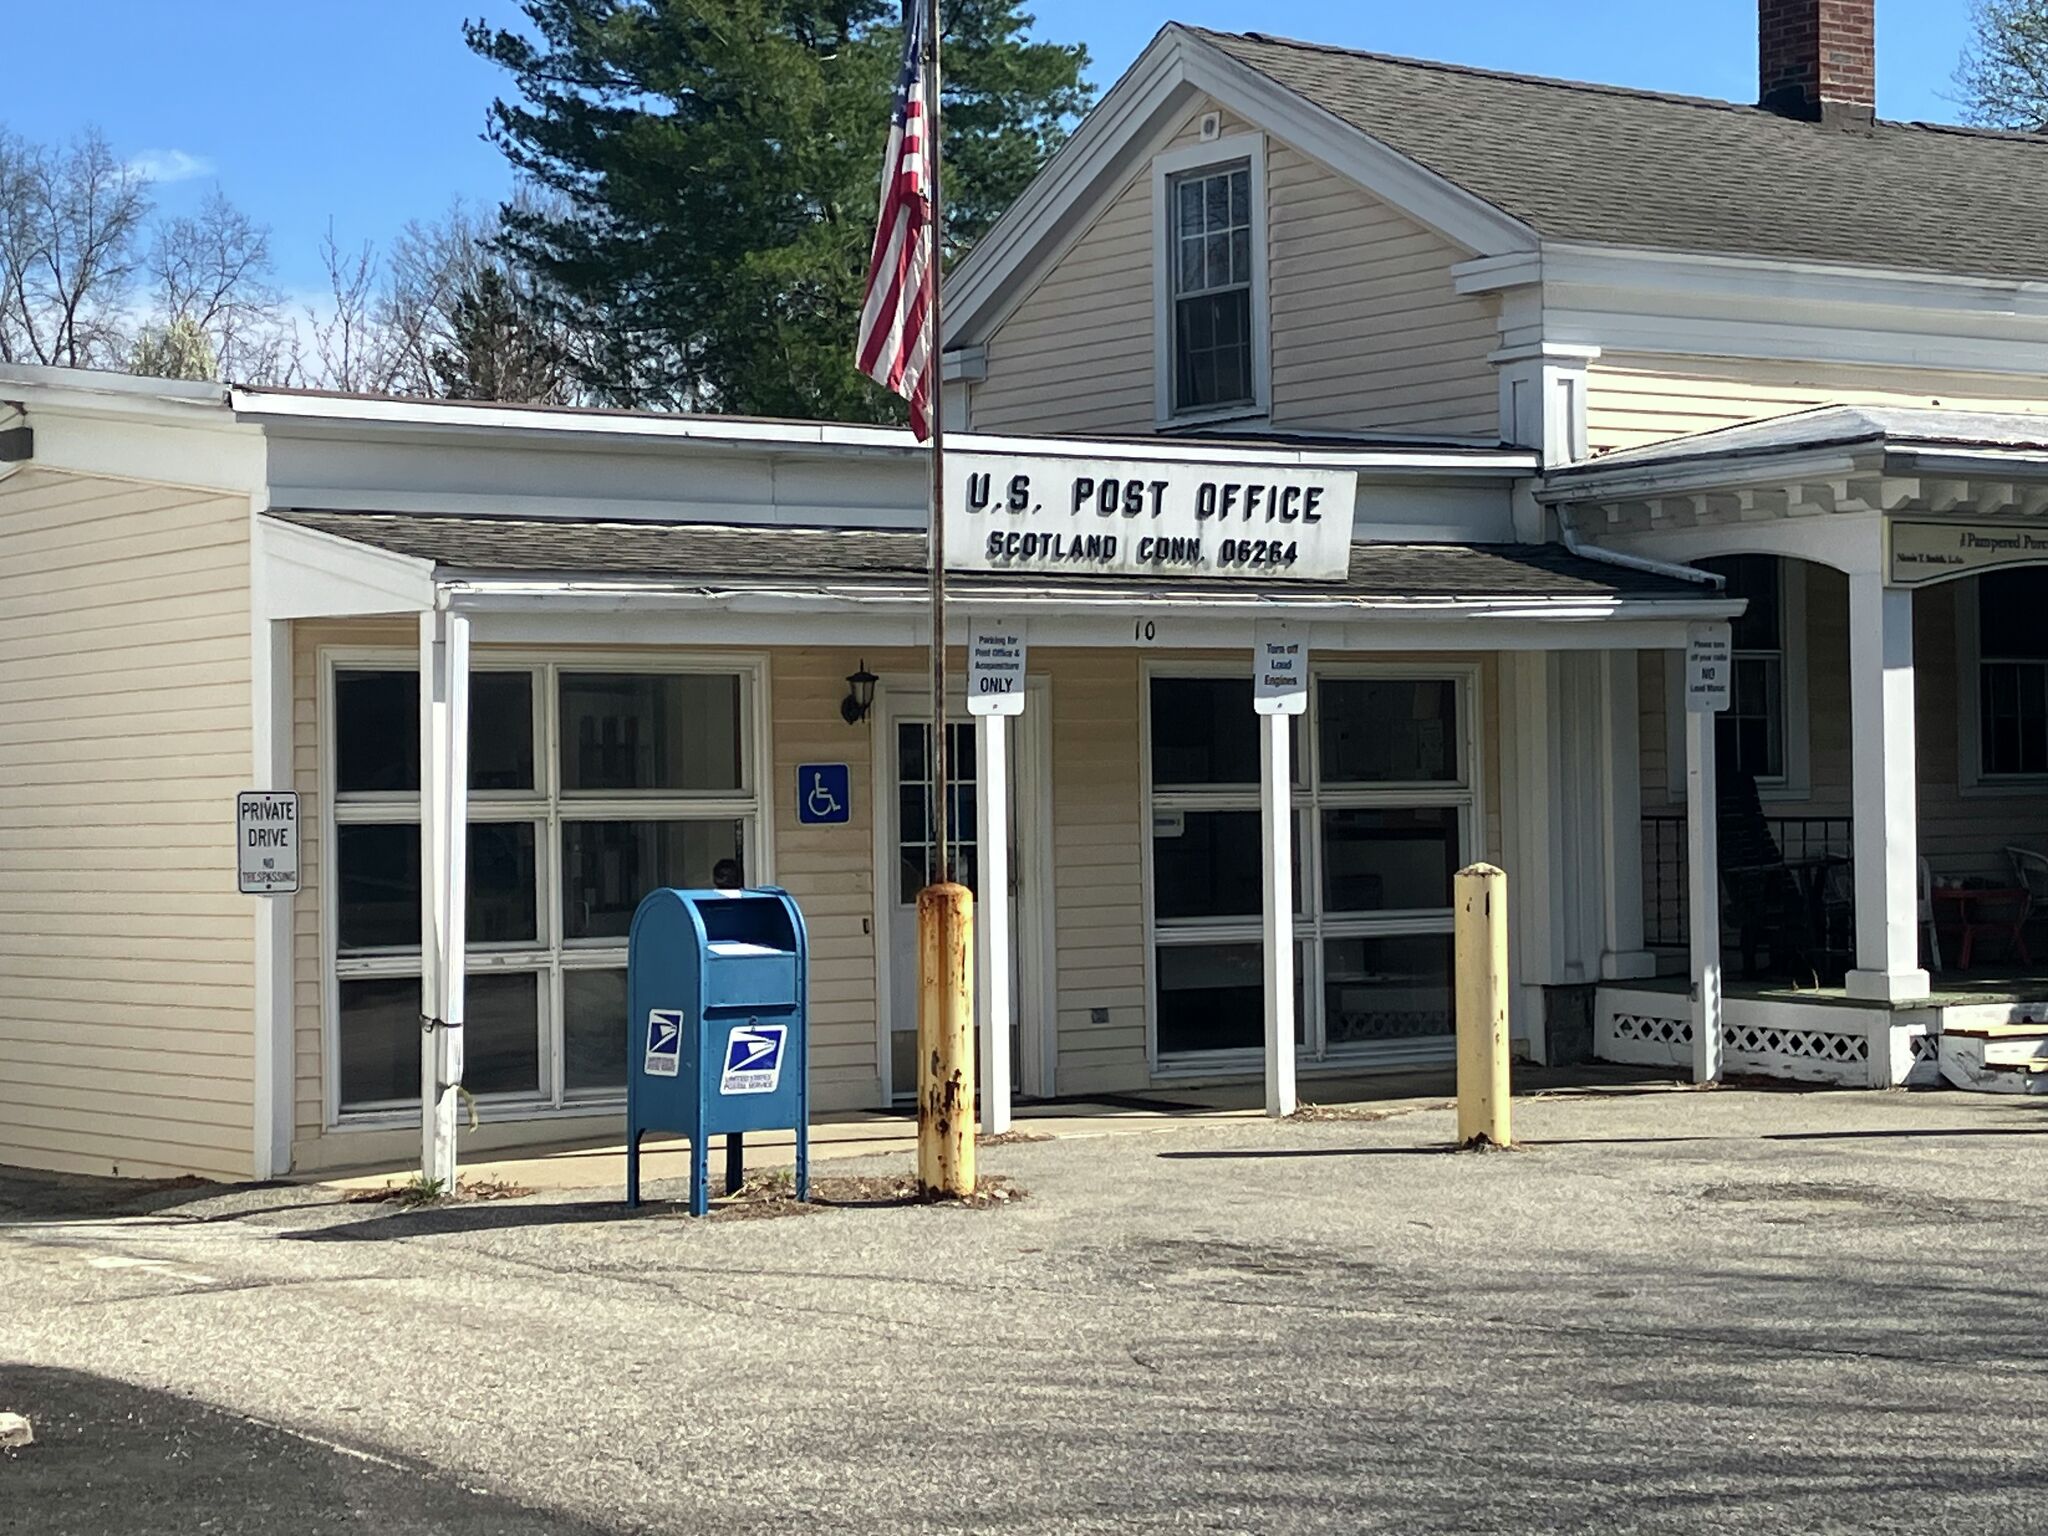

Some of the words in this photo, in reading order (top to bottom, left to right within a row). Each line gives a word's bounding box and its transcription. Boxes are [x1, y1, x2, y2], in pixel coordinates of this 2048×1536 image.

[966, 471, 1043, 515] U.S.
[1071, 476, 1168, 519] POST
[1195, 481, 1324, 524] OFFICE
[986, 529, 1117, 562] SCOTLAND
[1136, 535, 1206, 564] CONN.
[1217, 538, 1299, 569] 06264
[1135, 620, 1155, 641] 10
[979, 635, 1006, 646] Parking
[975, 648, 991, 657] Post
[992, 648, 1013, 658] Office
[1266, 643, 1285, 654] Turn
[1286, 643, 1299, 654] off
[1271, 659, 1292, 670] Loud
[1701, 667, 1715, 680] NO
[980, 677, 1013, 693] ONLY
[1264, 674, 1297, 688] Engines
[242, 801, 295, 821] PRIVATE
[248, 828, 289, 847] DRIVE
[263, 858, 275, 869] NO
[243, 871, 295, 883] TRESPASSING
